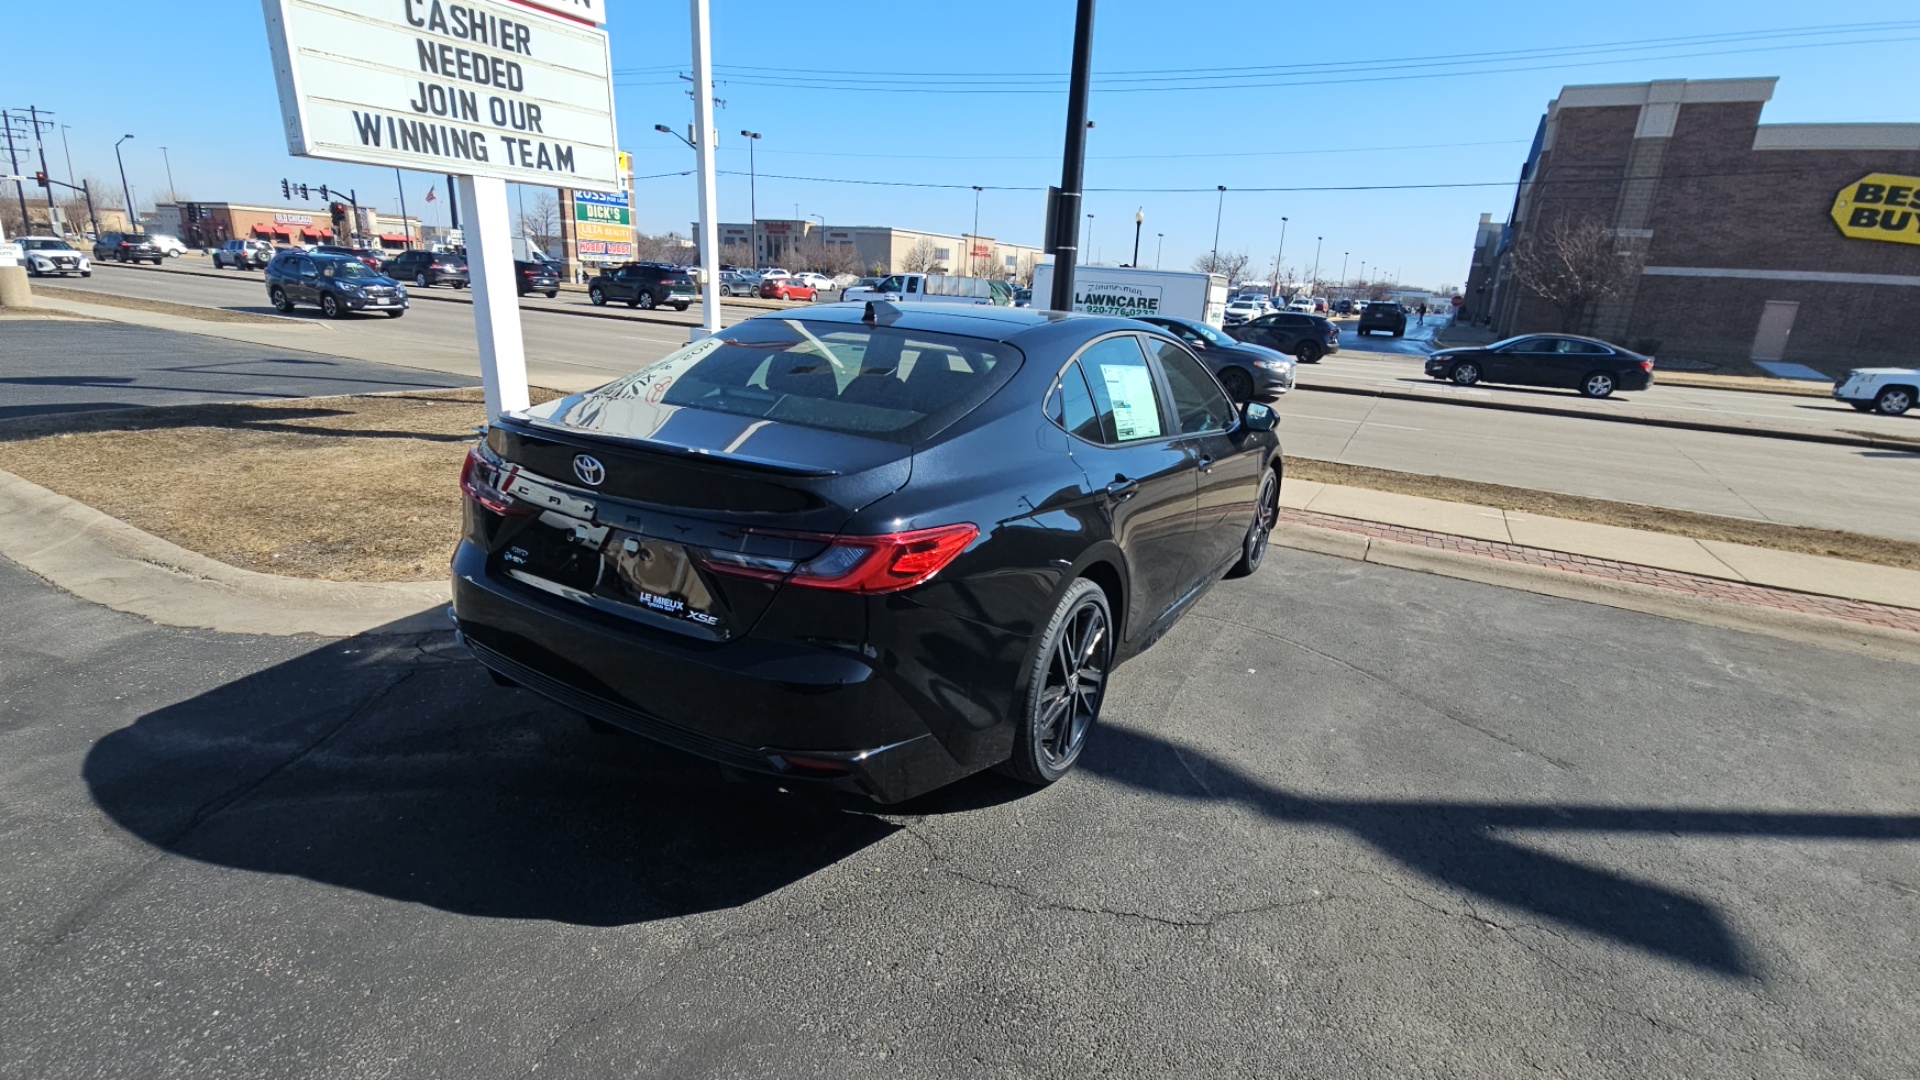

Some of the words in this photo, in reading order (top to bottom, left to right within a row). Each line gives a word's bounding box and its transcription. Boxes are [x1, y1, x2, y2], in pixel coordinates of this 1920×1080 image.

[405, 0, 532, 56] CASHIER
[416, 38, 524, 92] NEEDED
[410, 81, 479, 122] JOIN
[489, 96, 544, 133] OUR
[352, 110, 489, 162] WINNING
[500, 135, 575, 173] TEAM
[587, 204, 620, 220] DICK'S
[1848, 207, 1920, 233] BU
[581, 224, 603, 235] ULTA
[605, 229, 630, 237] BEAUTY
[580, 242, 604, 253] HOBBY
[608, 243, 630, 255] LOBBY
[1075, 293, 1158, 310] LAWNCARE
[640, 591, 652, 602] LE
[653, 595, 684, 611] MIEUX
[686, 610, 718, 626] XSE
